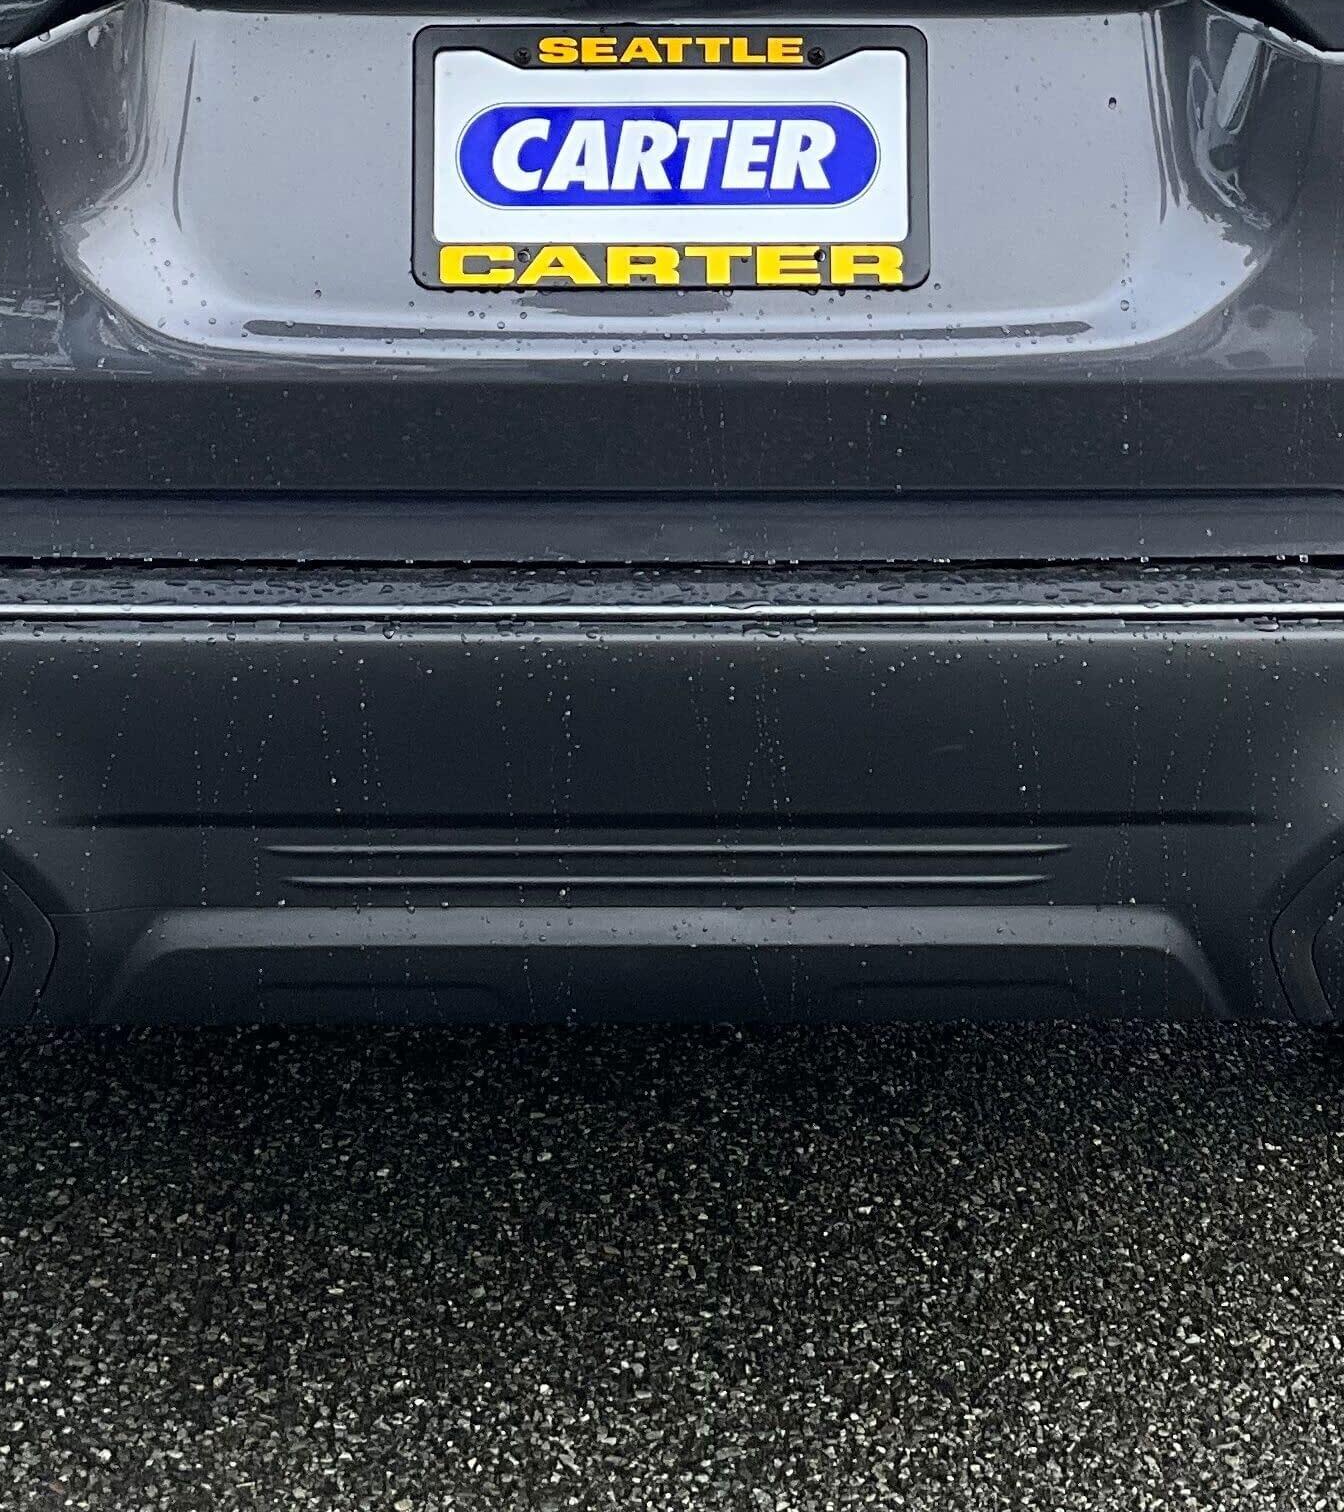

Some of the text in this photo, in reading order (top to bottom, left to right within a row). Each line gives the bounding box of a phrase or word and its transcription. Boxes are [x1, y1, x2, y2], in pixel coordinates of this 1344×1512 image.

[538, 36, 805, 64] SEATTLE
[492, 117, 837, 191] CARTER
[439, 244, 904, 285] CARTER
